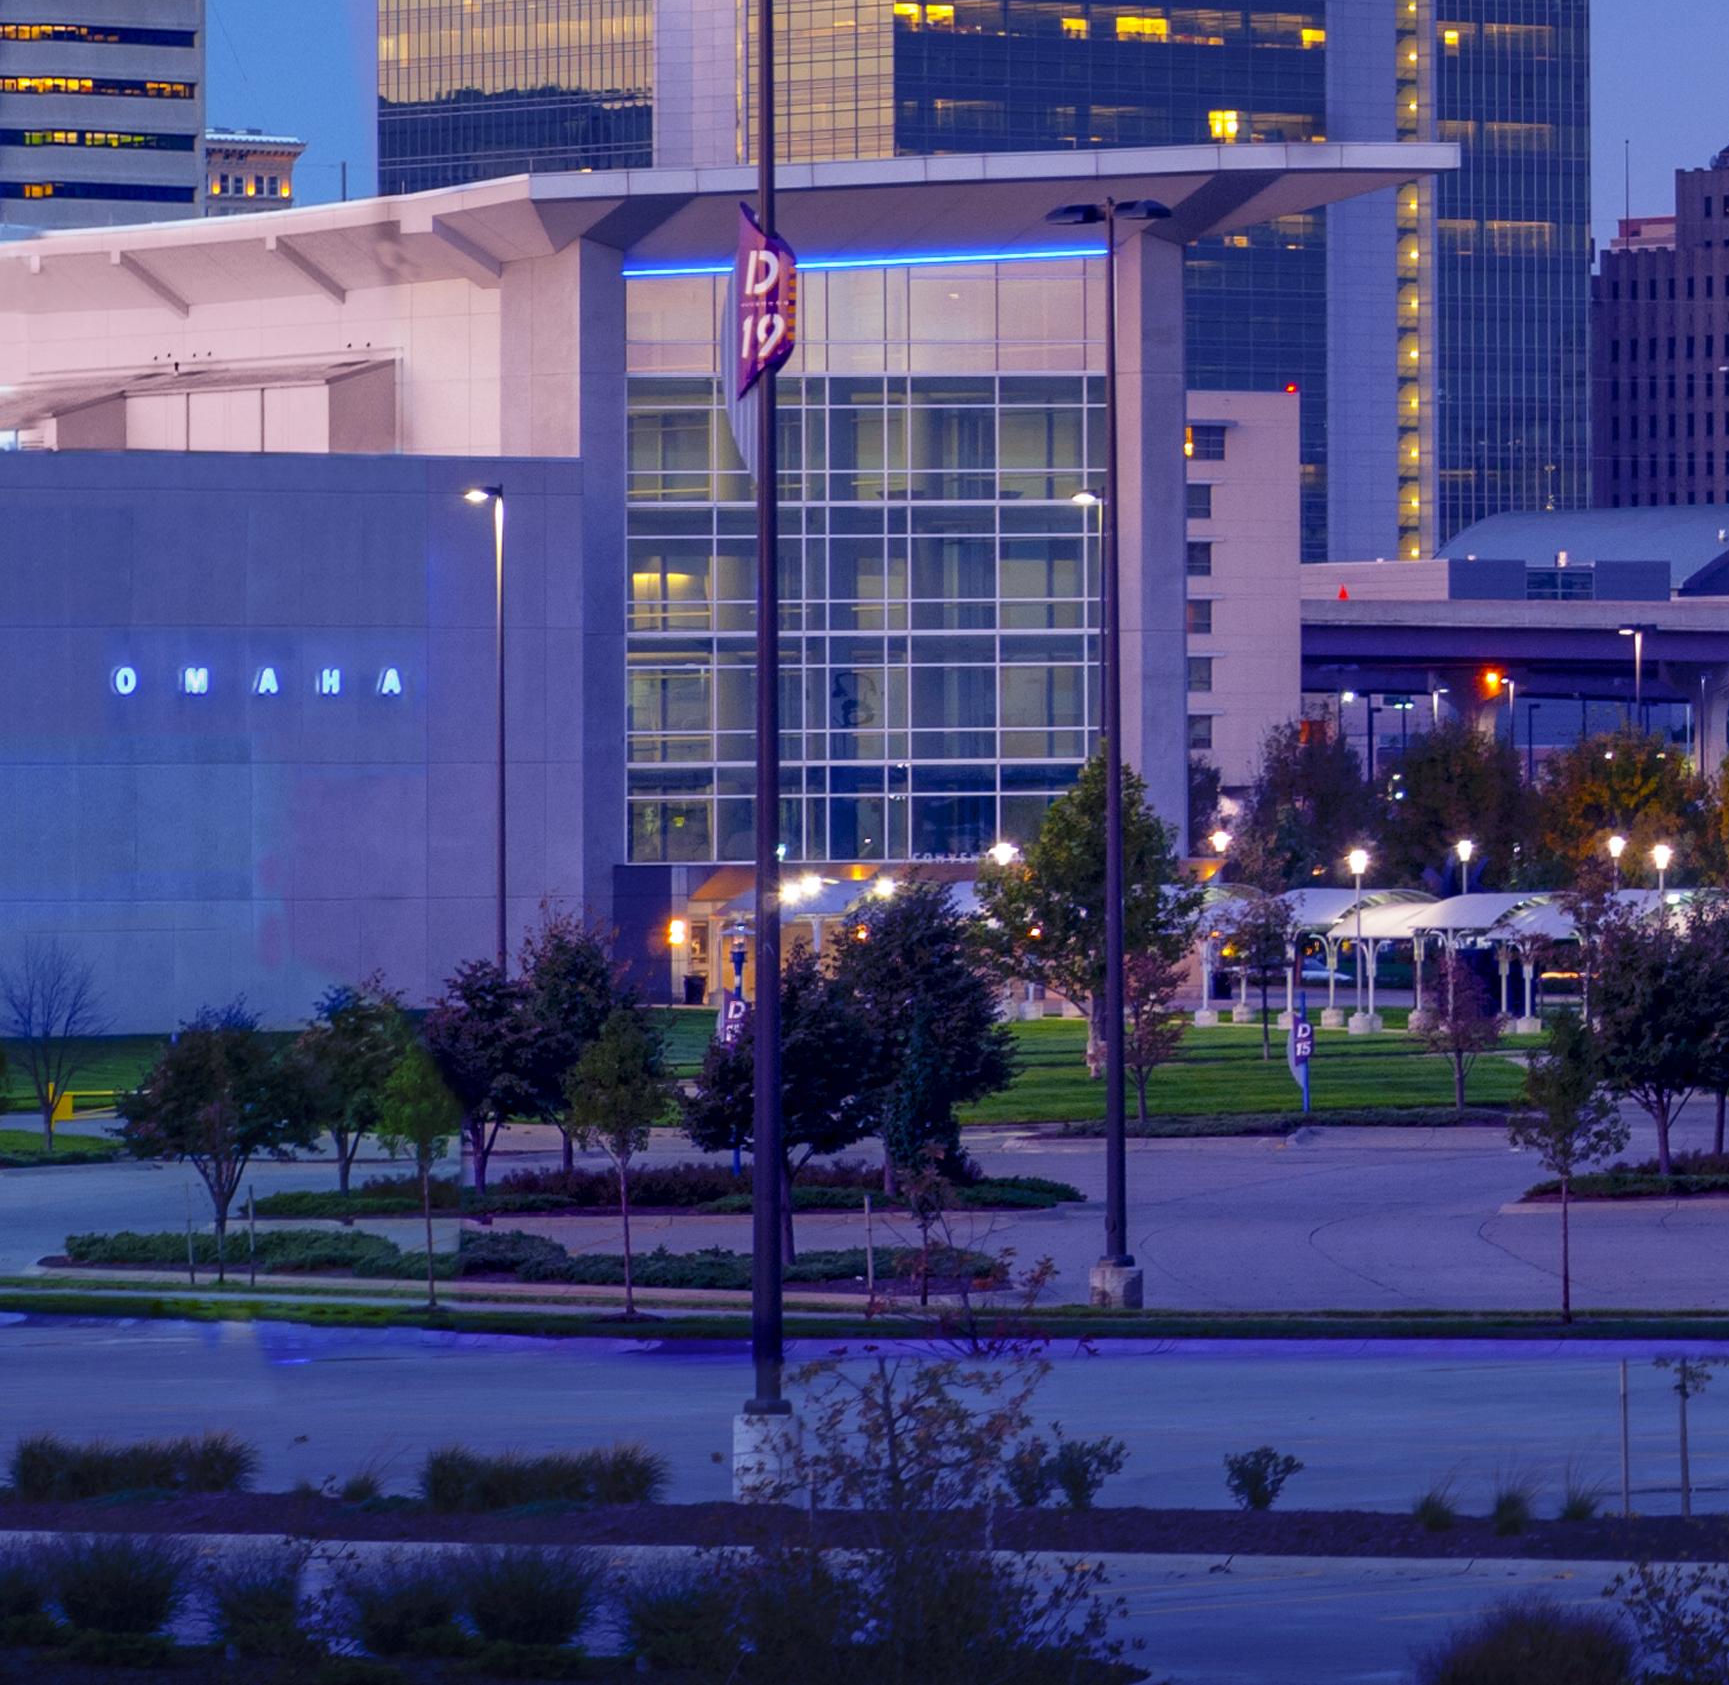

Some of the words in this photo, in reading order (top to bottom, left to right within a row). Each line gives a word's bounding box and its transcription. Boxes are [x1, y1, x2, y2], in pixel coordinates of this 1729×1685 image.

[744, 249, 780, 296] D
[741, 313, 786, 359] 19
[111, 667, 402, 695] OMAHA
